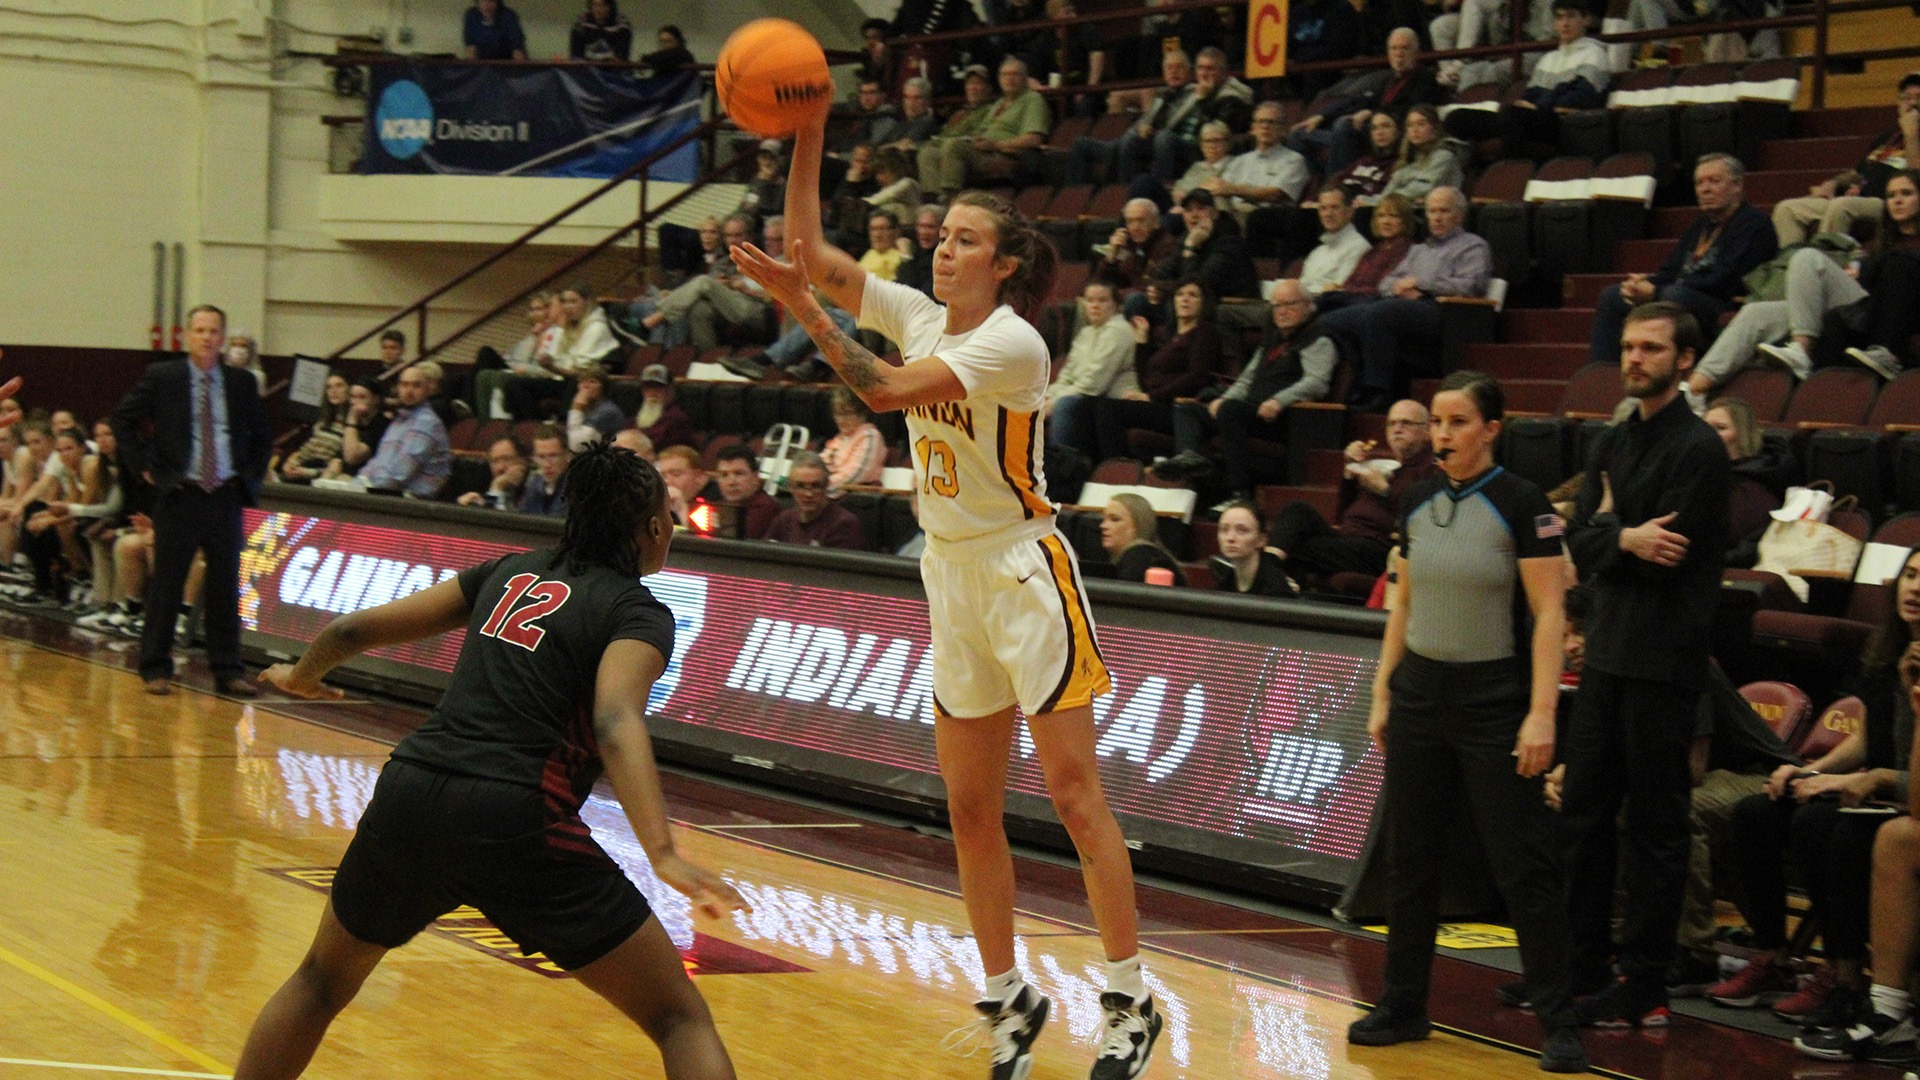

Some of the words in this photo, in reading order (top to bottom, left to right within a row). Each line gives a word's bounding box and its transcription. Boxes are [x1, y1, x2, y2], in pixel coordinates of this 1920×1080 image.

[1254, 3, 1280, 67] C
[380, 118, 432, 140] NCAA
[436, 118, 514, 142] Division
[915, 435, 959, 499] 13
[480, 573, 571, 652] 12
